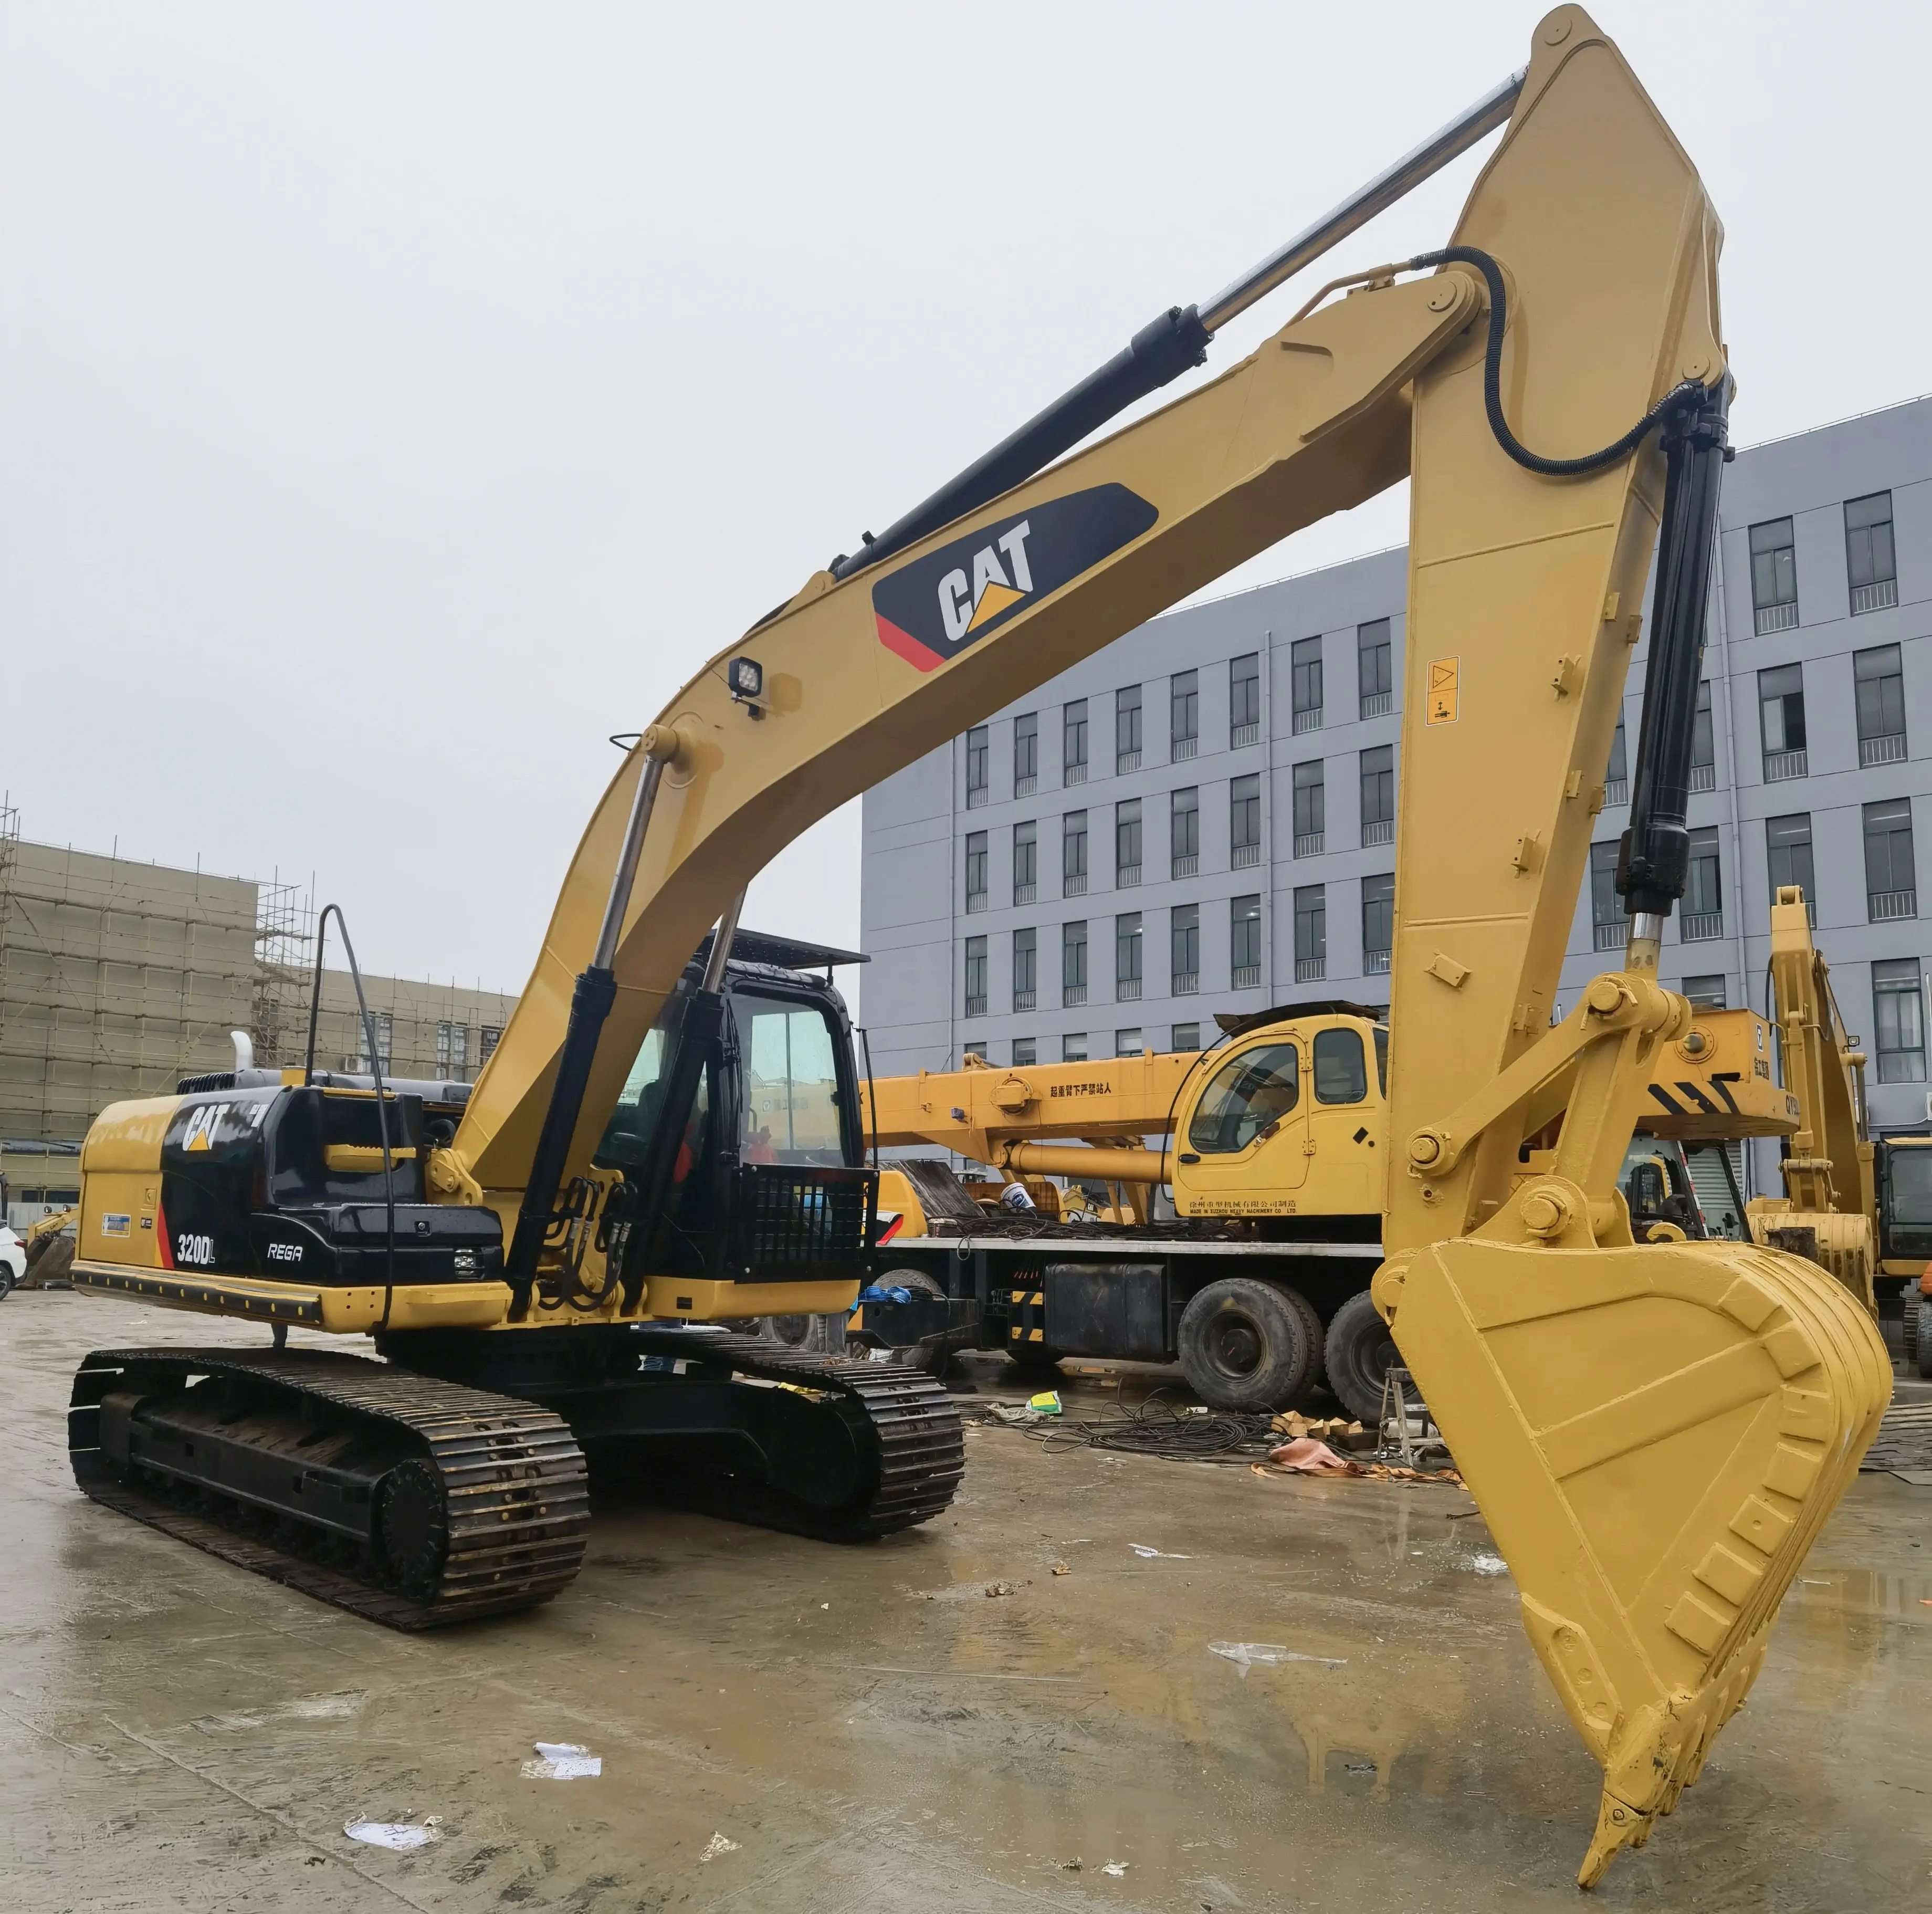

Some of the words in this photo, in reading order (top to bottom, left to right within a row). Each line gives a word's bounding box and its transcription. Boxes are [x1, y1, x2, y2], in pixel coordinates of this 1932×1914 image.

[938, 519, 1034, 641] CAT
[1051, 1082, 1111, 1097] 起重臂下严禁站人
[182, 1104, 230, 1151] CAT
[267, 1243, 303, 1262] REGA
